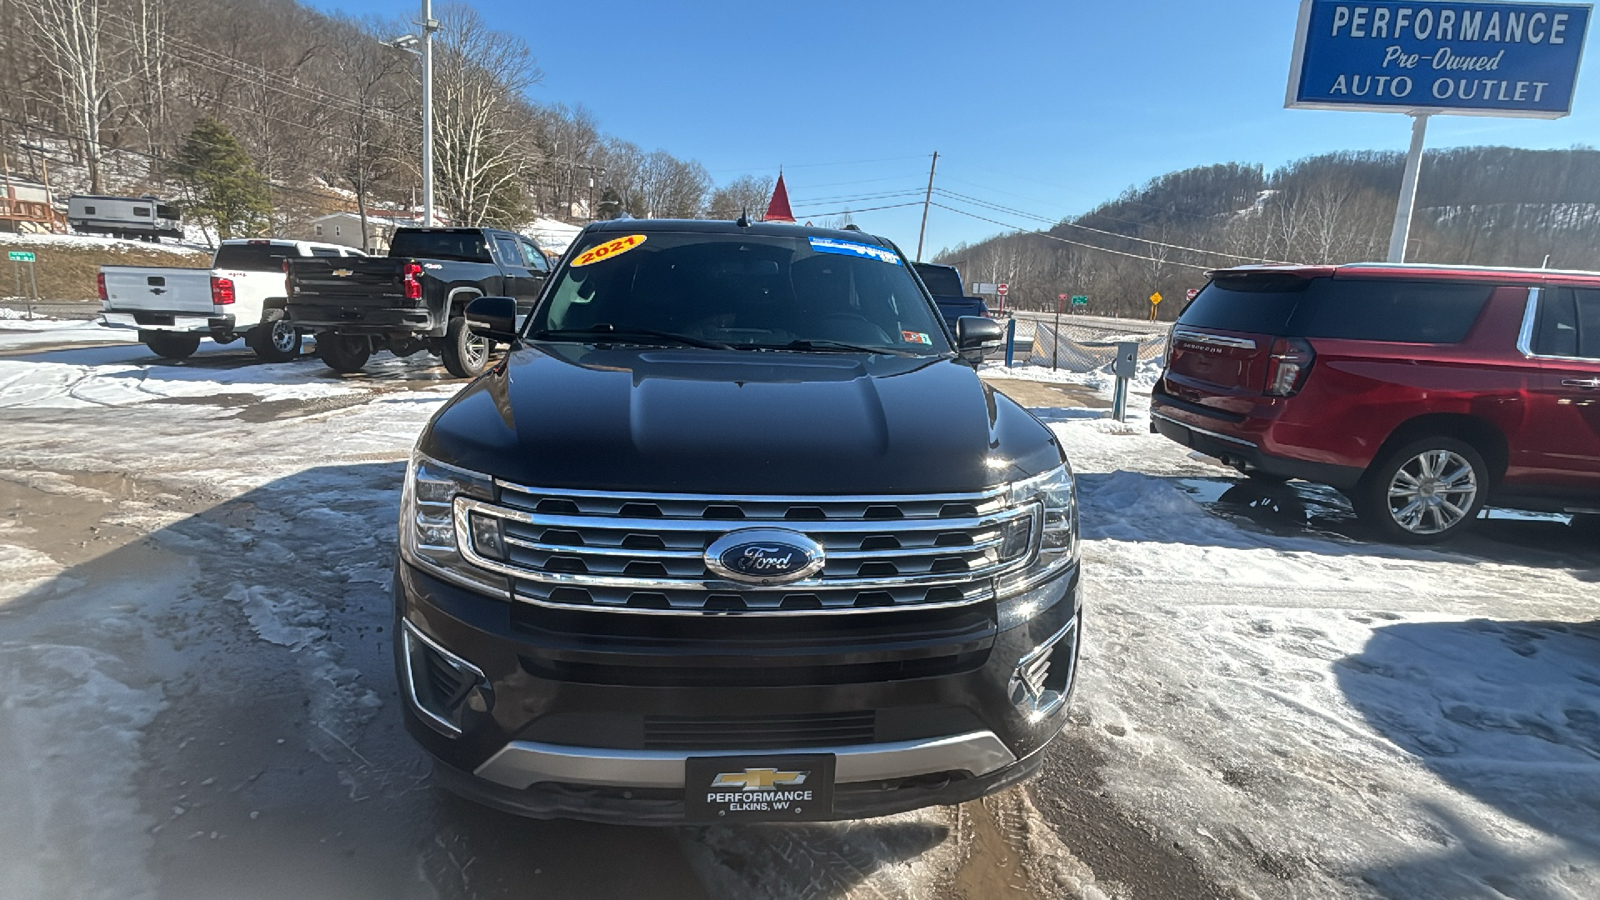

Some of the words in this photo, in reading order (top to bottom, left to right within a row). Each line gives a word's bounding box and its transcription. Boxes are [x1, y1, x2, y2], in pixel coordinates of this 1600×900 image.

[1332, 7, 1569, 44] PERFORMANCE
[1382, 46, 1504, 71] Pre-Owned
[1329, 75, 1413, 98] AUTO
[1432, 78, 1549, 102] OUTLET
[581, 237, 634, 264] 2021
[738, 546, 792, 570] Ford
[707, 791, 812, 803] PERFORMANCE
[730, 803, 771, 812] ELKINS,
[773, 802, 790, 810] WV
